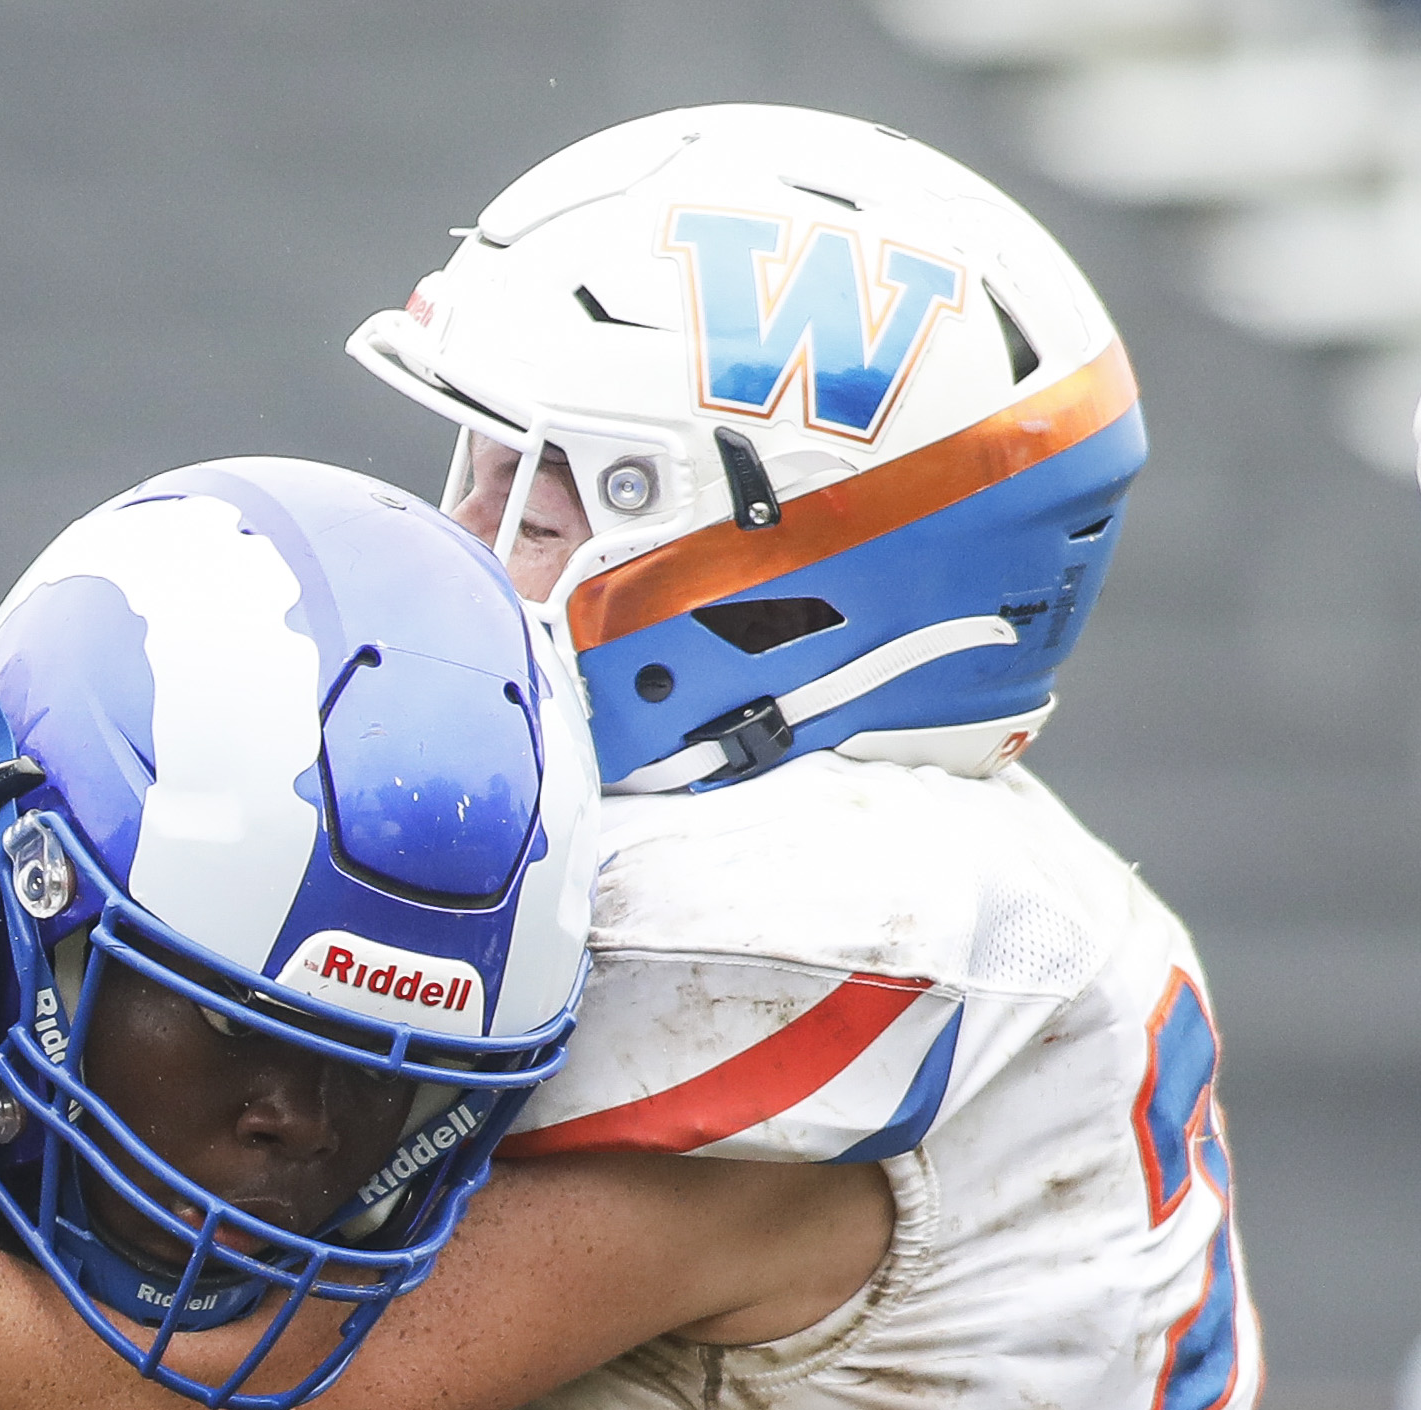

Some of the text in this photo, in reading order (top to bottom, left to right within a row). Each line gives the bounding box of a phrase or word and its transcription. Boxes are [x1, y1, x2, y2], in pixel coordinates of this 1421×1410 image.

[658, 203, 966, 446] W
[320, 945, 473, 1011] Riddell
[357, 1103, 477, 1205] Riddell
[136, 1283, 218, 1311] Ridell
